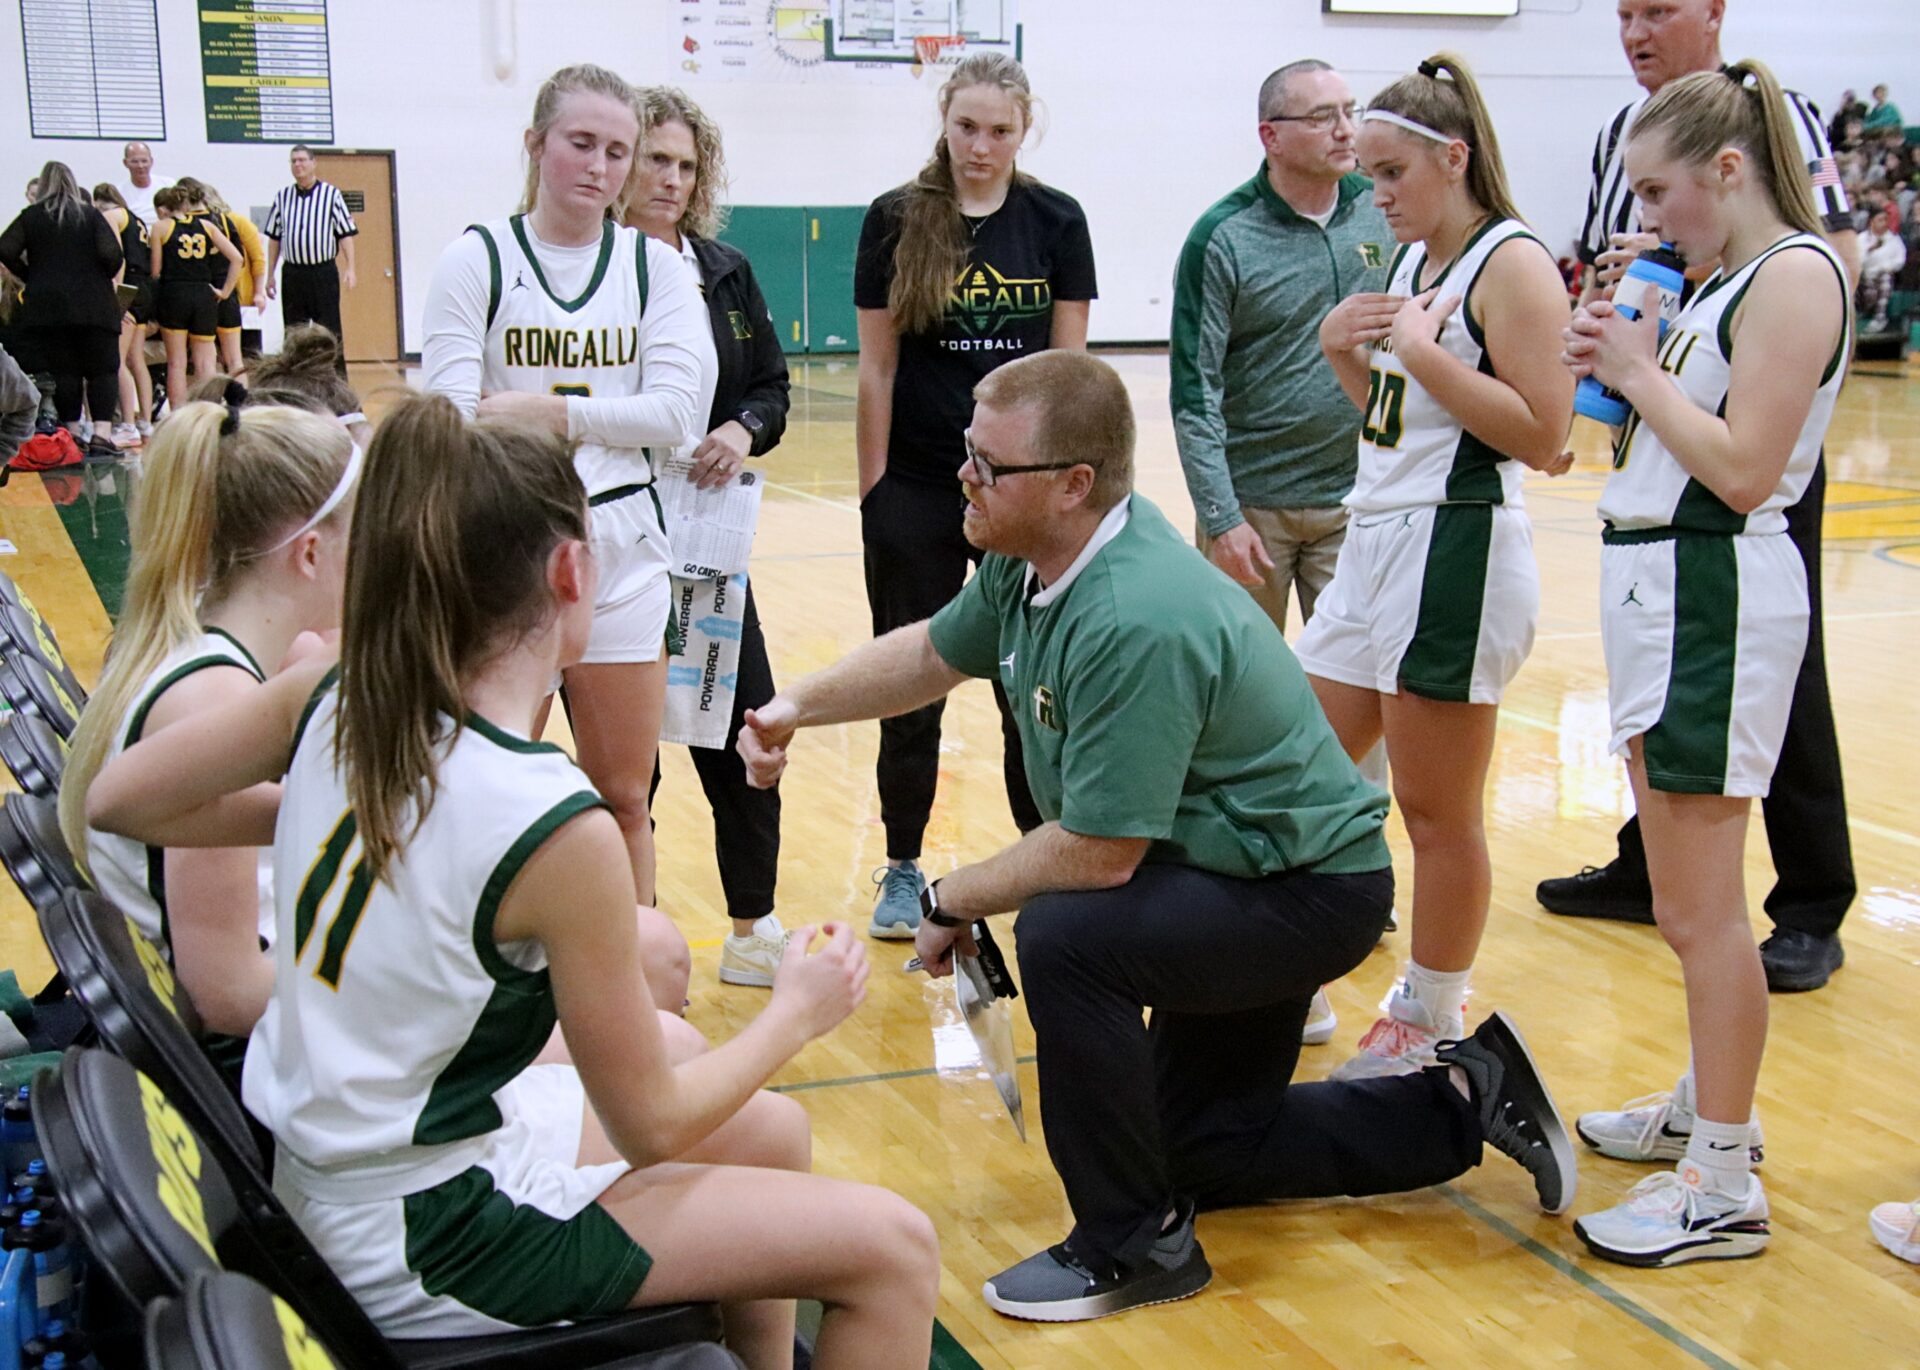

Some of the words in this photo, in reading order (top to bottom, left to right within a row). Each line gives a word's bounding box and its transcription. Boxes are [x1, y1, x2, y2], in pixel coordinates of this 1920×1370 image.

[177, 233, 206, 259] 33
[945, 284, 1051, 313] NCALLI
[504, 326, 638, 369] RONCALLI
[940, 338, 1024, 351] FOOTBALL
[683, 562, 697, 574] GO
[714, 575, 728, 614] POWE
[700, 640, 720, 712] POWERADE
[295, 805, 378, 993] 11
